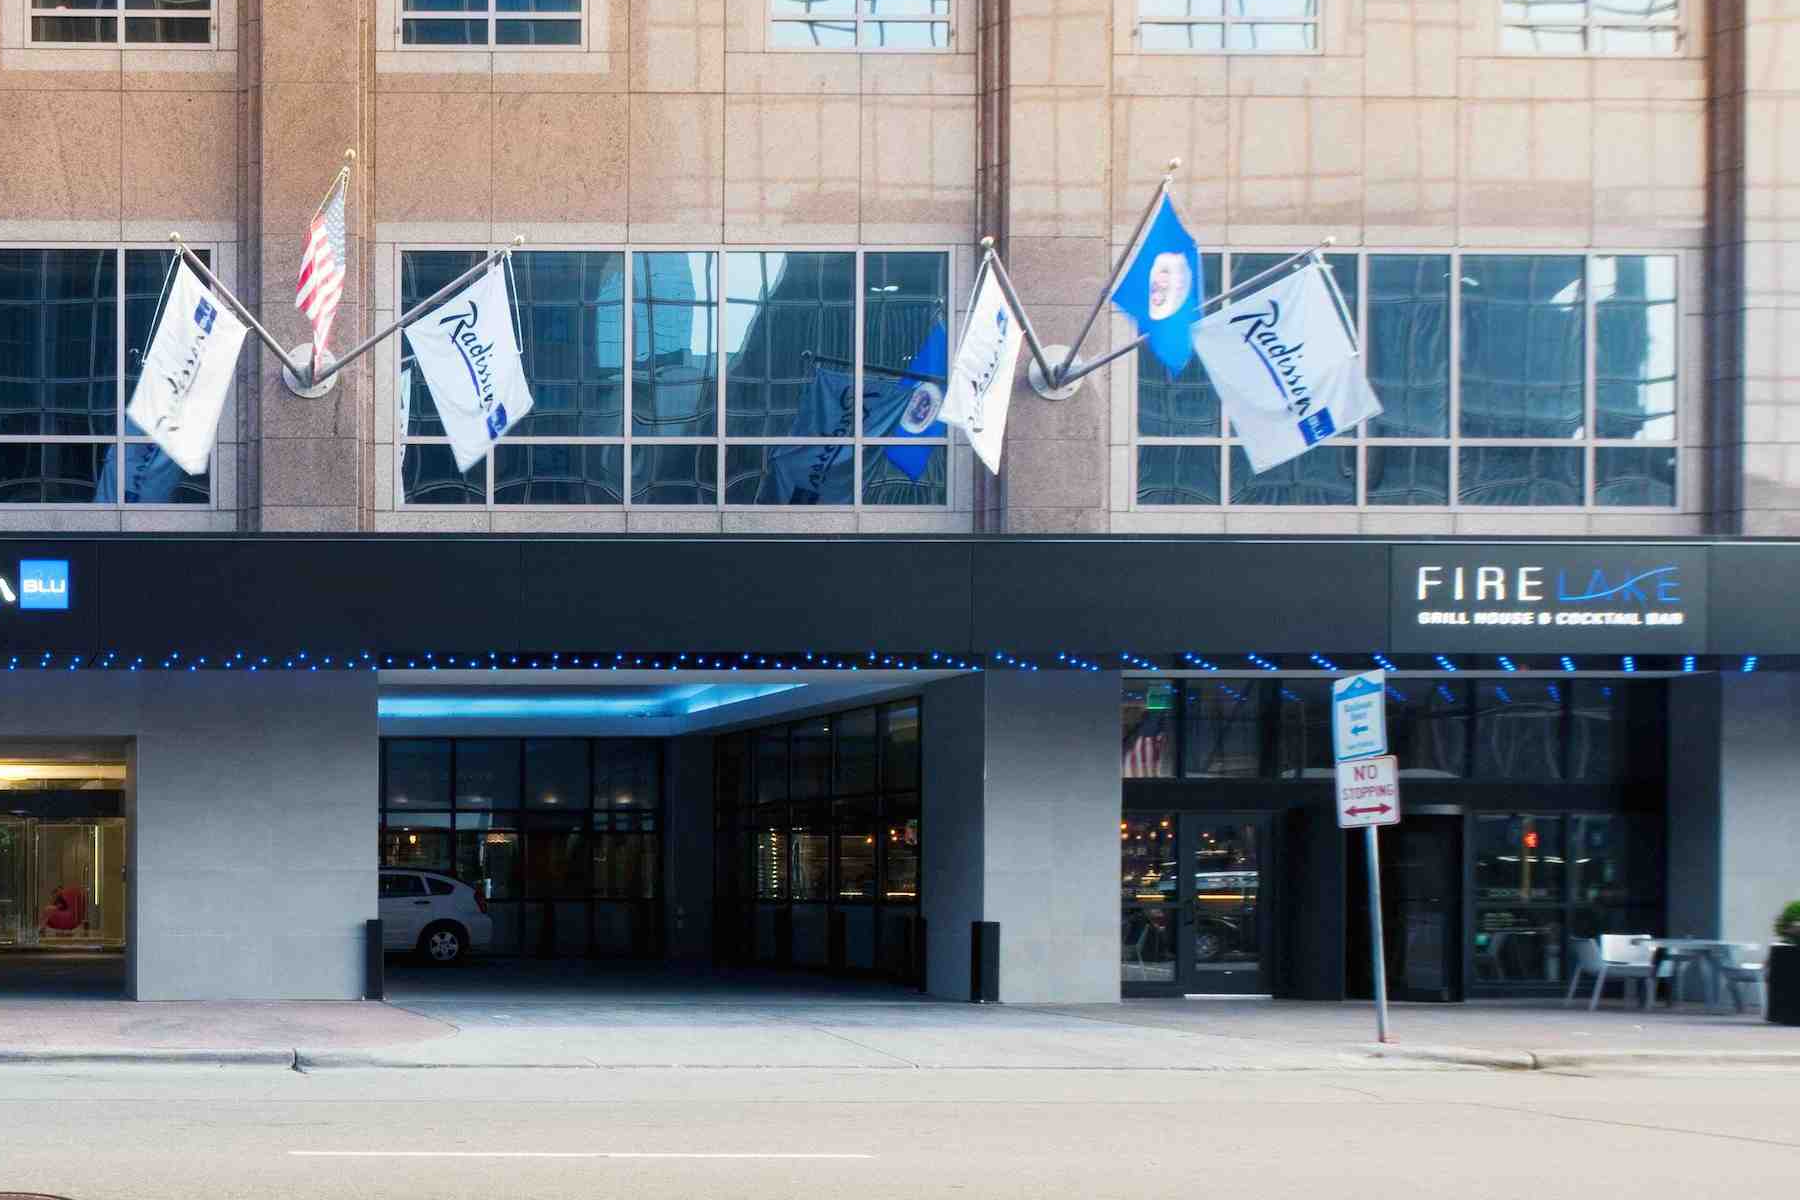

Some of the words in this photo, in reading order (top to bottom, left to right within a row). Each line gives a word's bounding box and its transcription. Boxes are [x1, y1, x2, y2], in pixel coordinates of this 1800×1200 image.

[1229, 300, 1312, 415] Radisson
[23, 578, 65, 593] BLU
[1417, 566, 1544, 601] FIRE
[1557, 567, 1681, 601] LAKE
[1417, 611, 1470, 625] GRILL
[1473, 611, 1534, 625] HOUSE
[1555, 611, 1643, 625] COCKTAIL
[1645, 611, 1684, 625] BAR
[1353, 765, 1377, 781] NO
[1342, 784, 1395, 800] STOPPING
